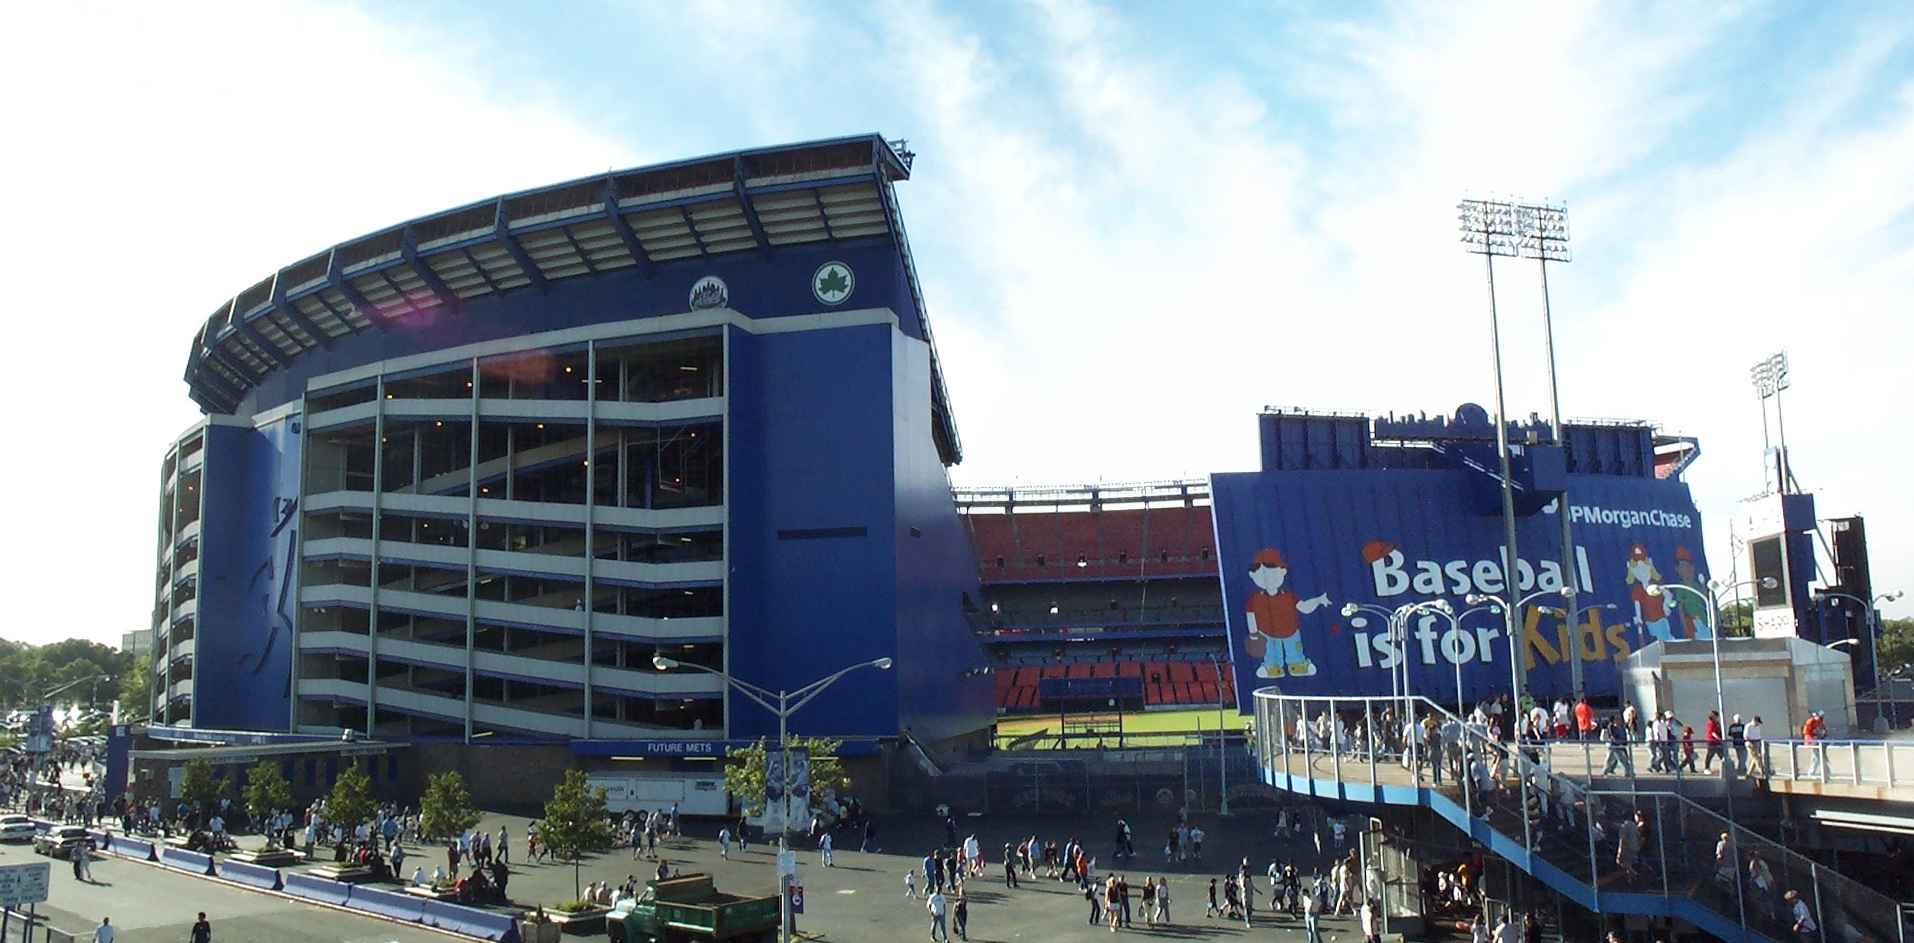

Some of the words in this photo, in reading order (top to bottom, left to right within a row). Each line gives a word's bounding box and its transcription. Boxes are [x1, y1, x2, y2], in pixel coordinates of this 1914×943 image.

[1568, 505, 1690, 528] PMorganChase
[1350, 617, 1402, 669] is
[1414, 614, 1499, 665] for
[1523, 604, 1631, 671] Kids
[648, 743, 682, 752] FUTURE
[686, 743, 711, 752] METS
